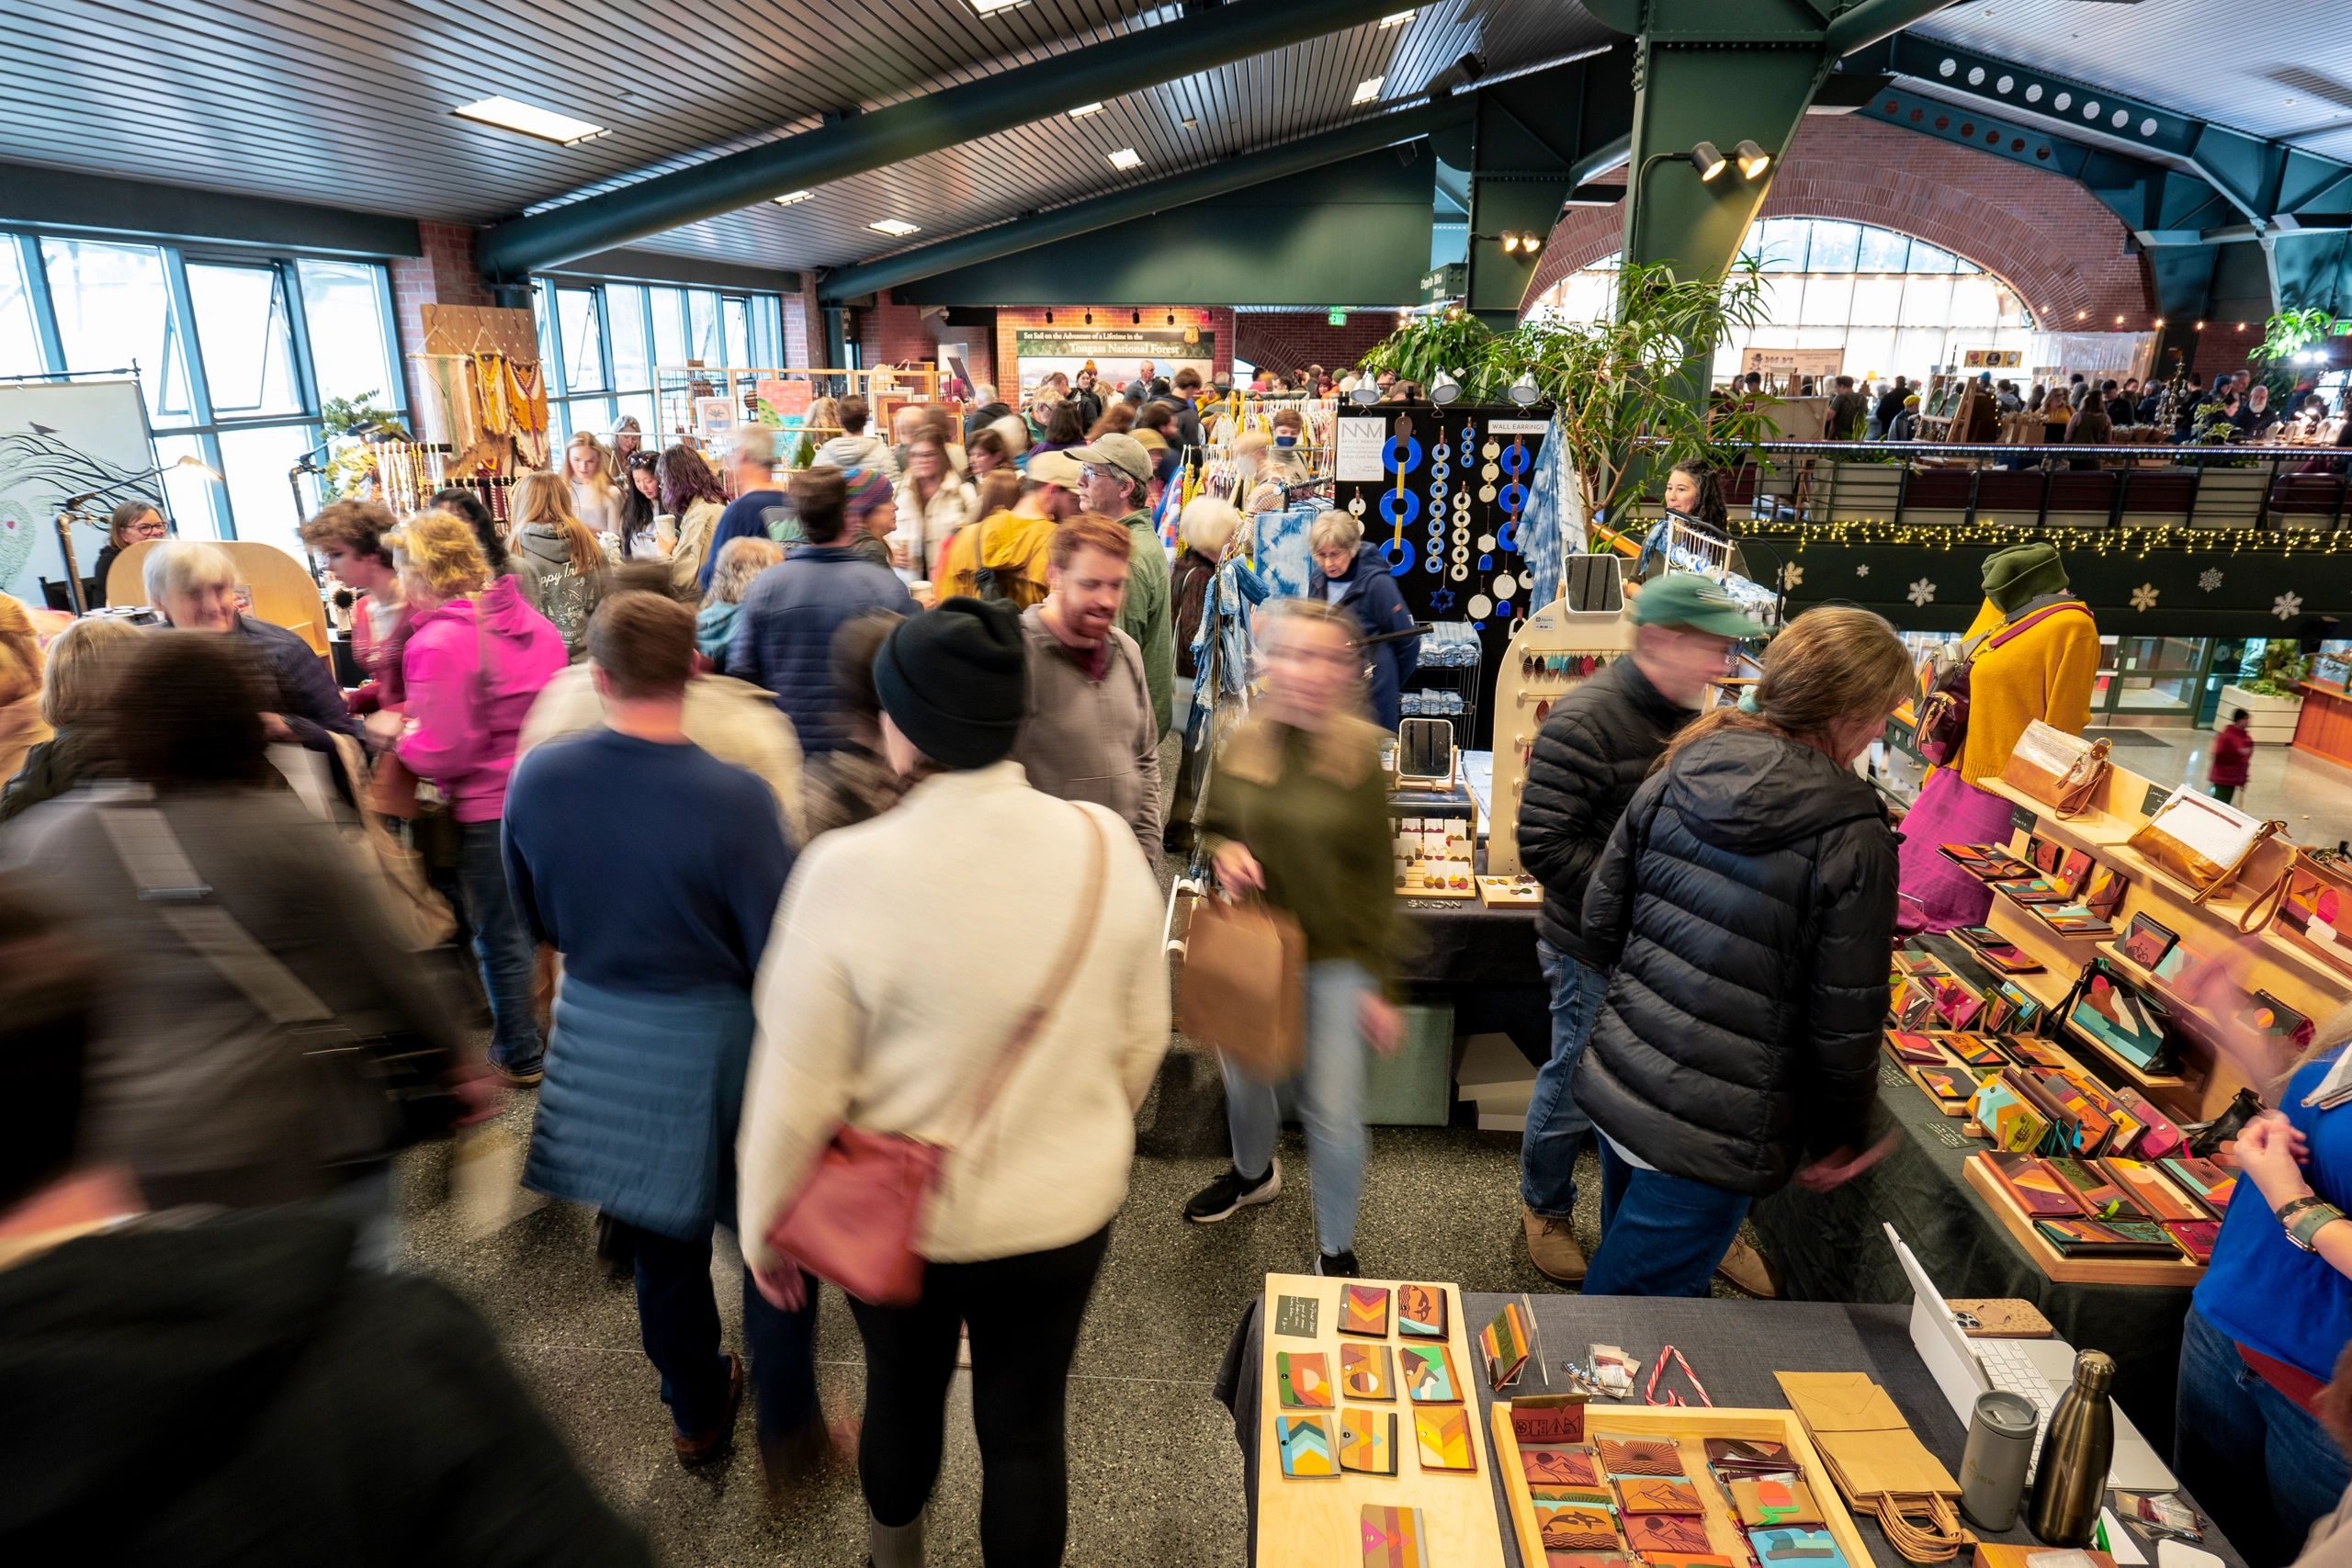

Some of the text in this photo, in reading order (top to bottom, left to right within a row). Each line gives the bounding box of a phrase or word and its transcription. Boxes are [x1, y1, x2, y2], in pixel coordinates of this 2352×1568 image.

[1023, 332, 1033, 340] Set
[1034, 332, 1044, 340] Sail
[1053, 332, 1062, 340] the
[1063, 332, 1091, 340] Adventure
[1103, 332, 1126, 341] Lifetime
[1127, 333, 1133, 341] in
[1134, 333, 1143, 341] the
[1069, 343, 1180, 356] Tongass National Forest
[540, 571, 562, 587] ppy
[1408, 898, 1463, 909] SNOW
